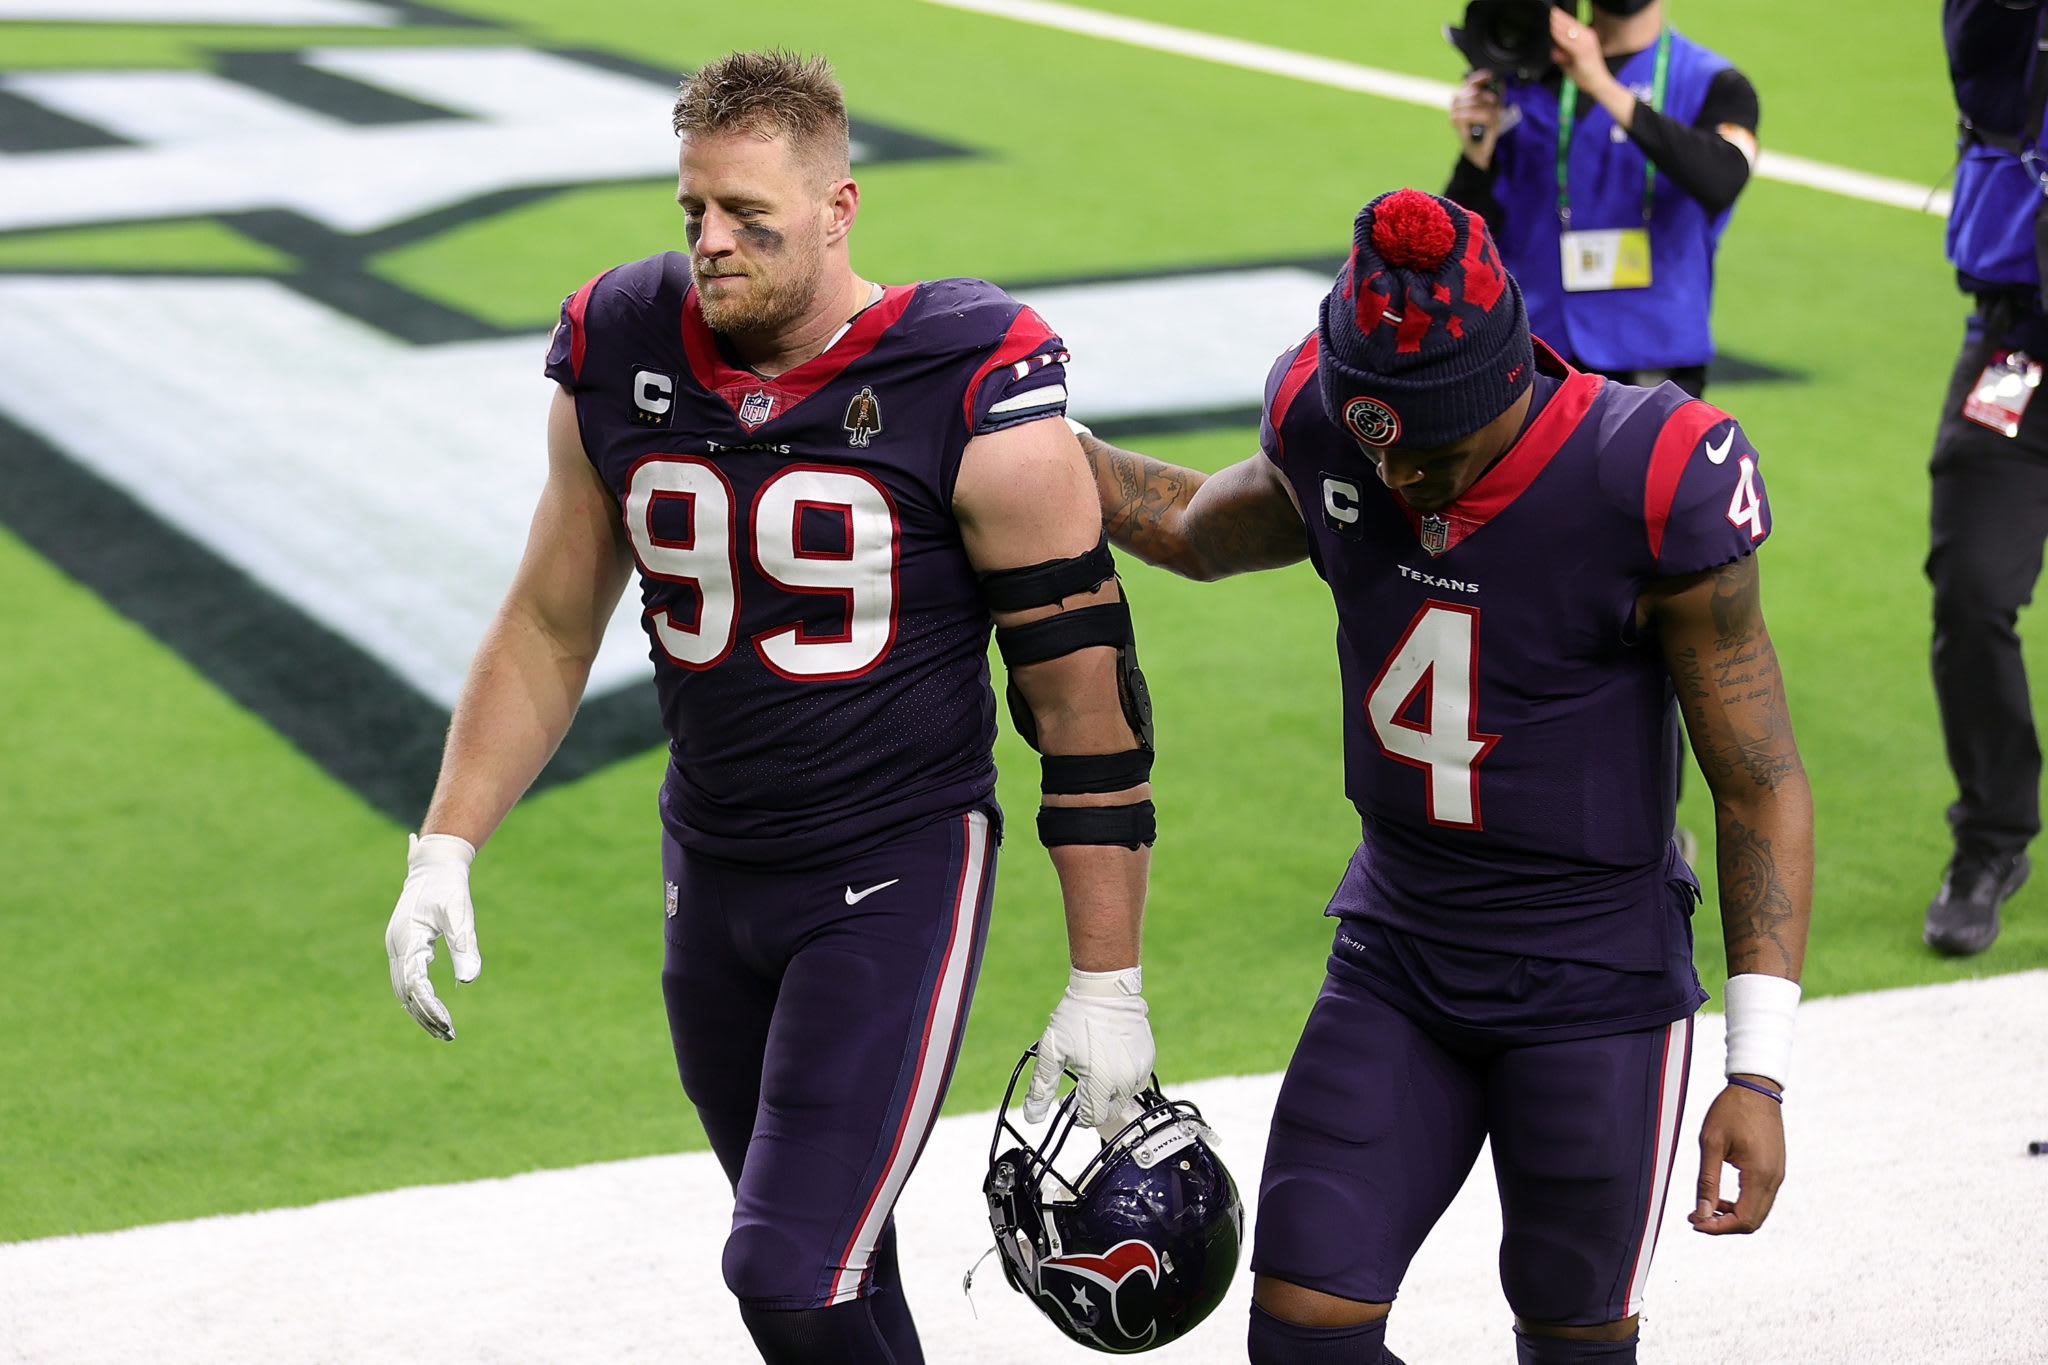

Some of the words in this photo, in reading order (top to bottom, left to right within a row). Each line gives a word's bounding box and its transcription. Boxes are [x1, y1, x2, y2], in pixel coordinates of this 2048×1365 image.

[634, 370, 672, 414] C
[743, 405, 766, 420] NFL
[706, 440, 791, 454] TANS
[1323, 479, 1359, 523] C
[1725, 454, 1766, 541] 4
[1424, 531, 1443, 547] NFL
[624, 453, 901, 682] 99
[1397, 564, 1480, 593] TEXANS
[1364, 598, 1503, 832] 4
[1153, 1135, 1183, 1152] TEXANS
